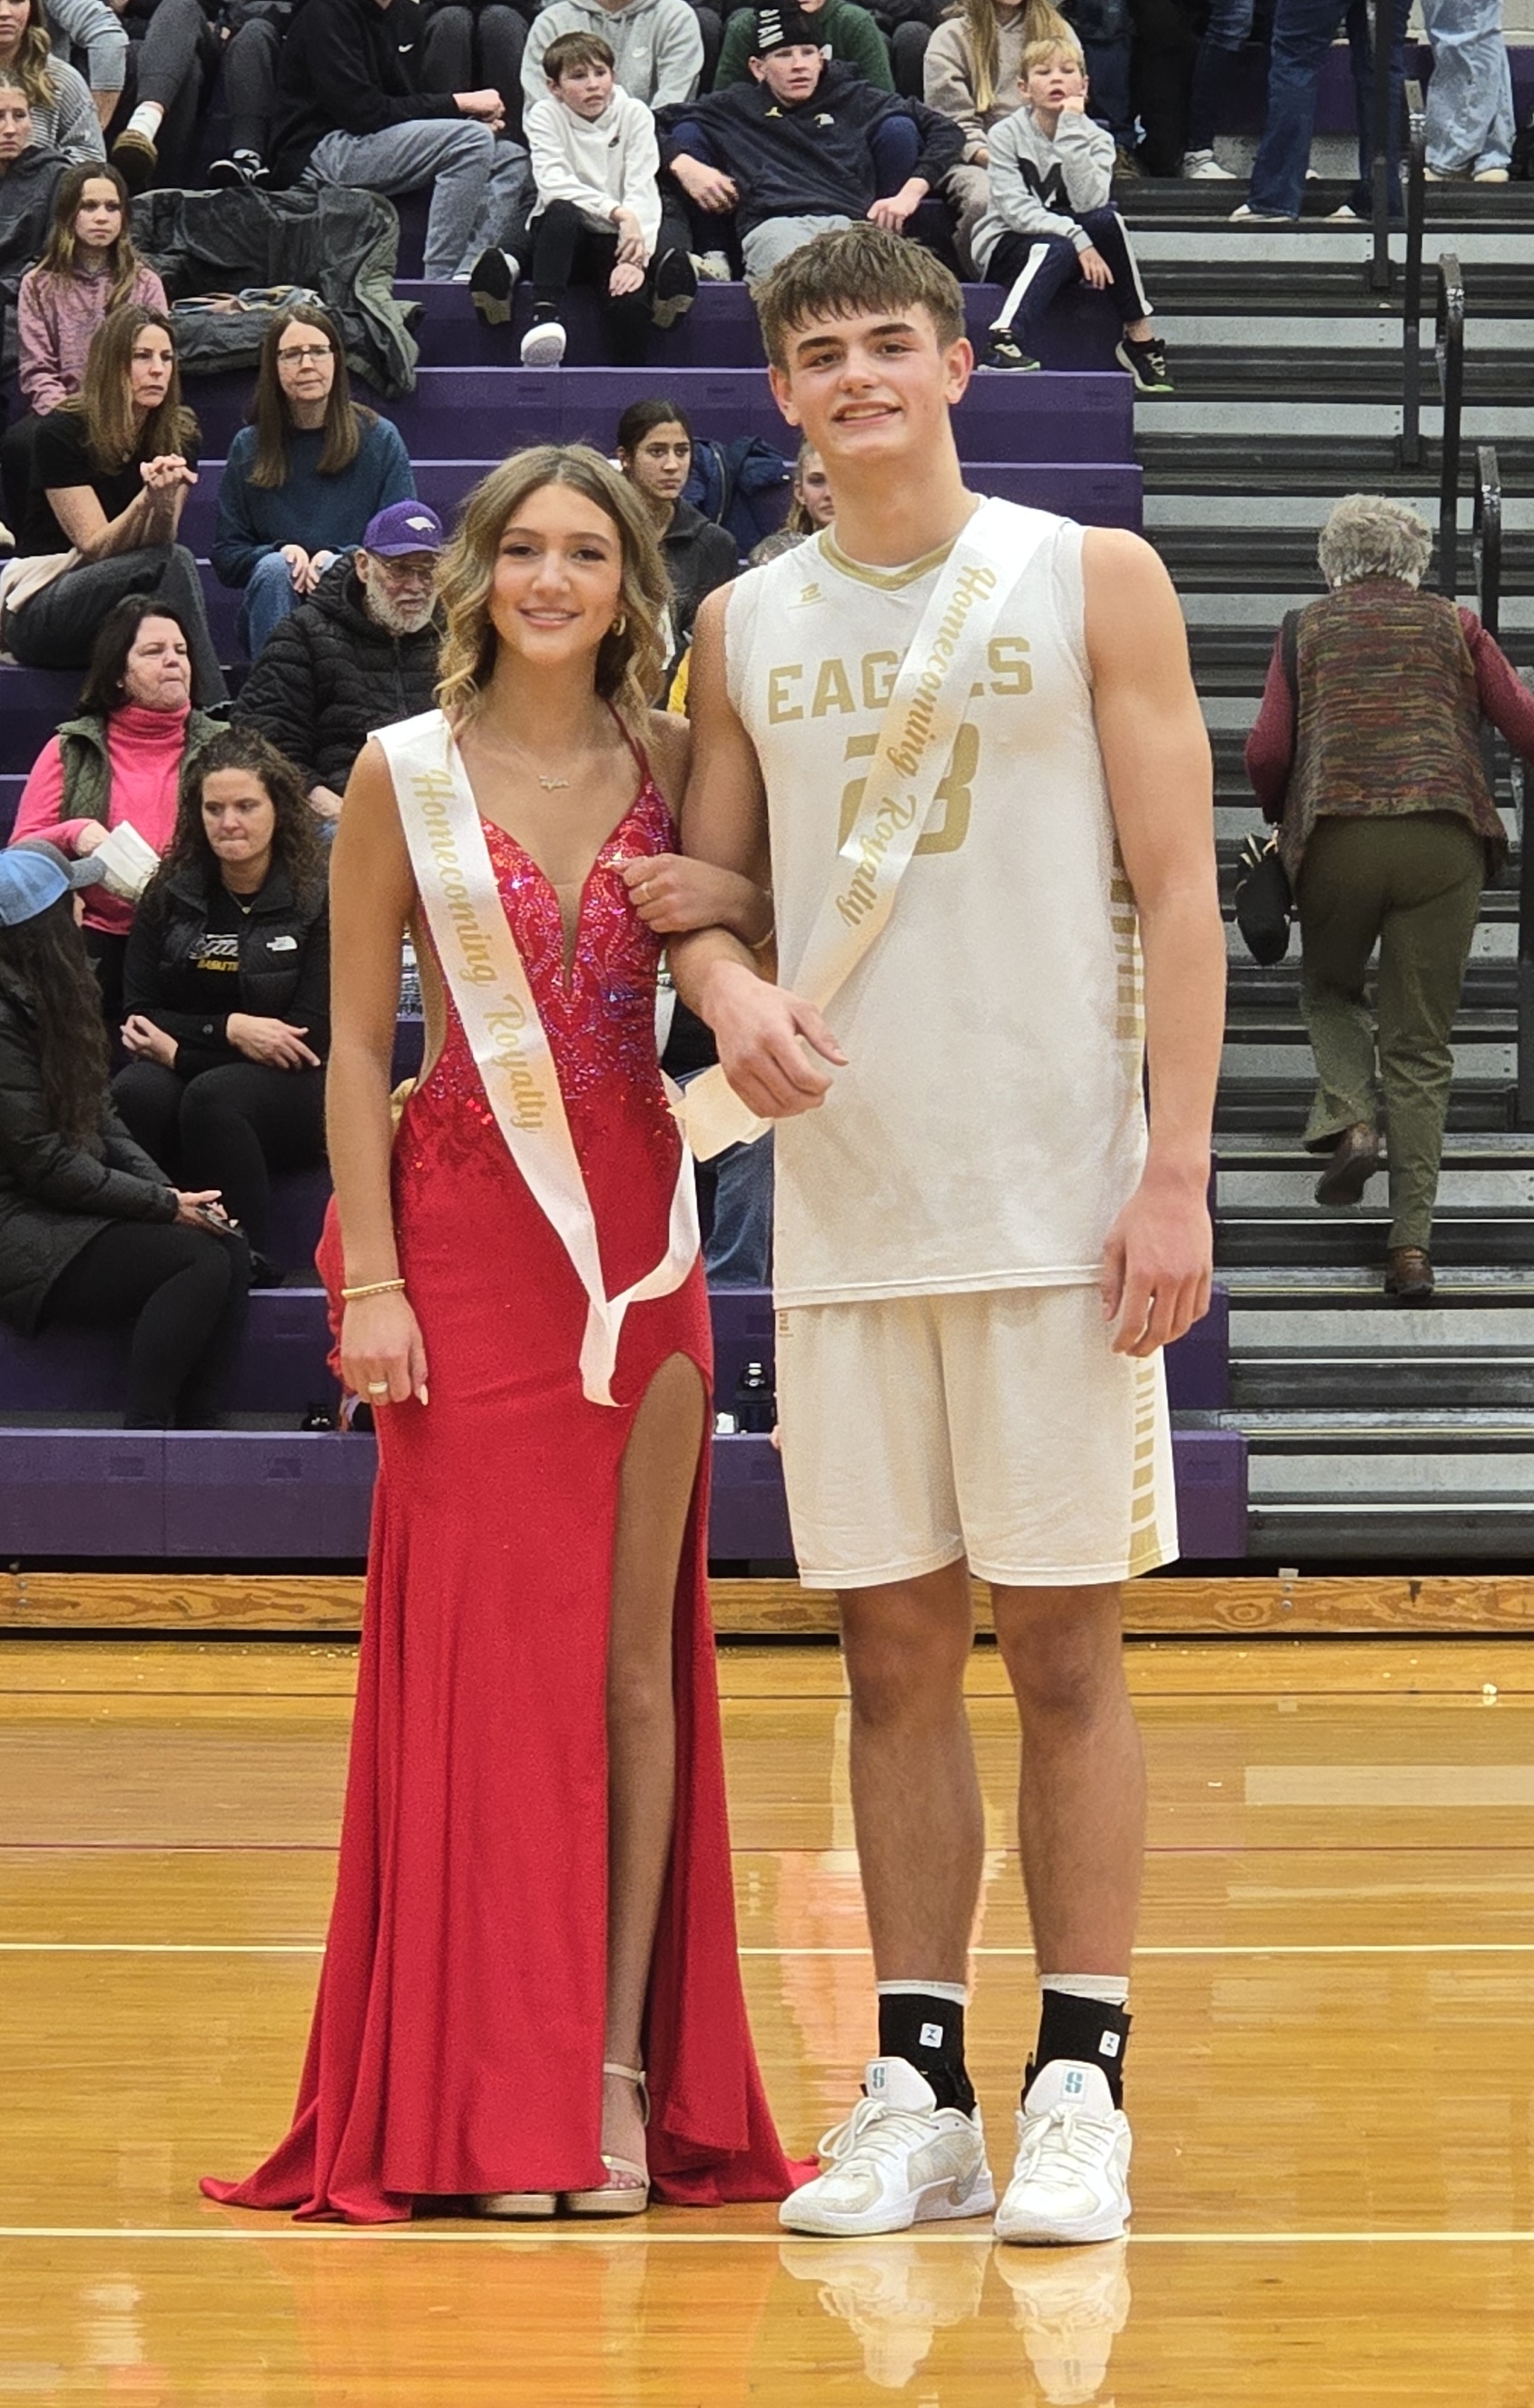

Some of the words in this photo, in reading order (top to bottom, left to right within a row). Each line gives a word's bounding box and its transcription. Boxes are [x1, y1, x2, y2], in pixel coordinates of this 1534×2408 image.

[767, 636, 1033, 724] EAGS
[886, 565, 997, 779] Homecoming
[835, 794, 917, 928] Royalty
[409, 769, 497, 988] Homecoming
[484, 993, 548, 1135] Royalty
